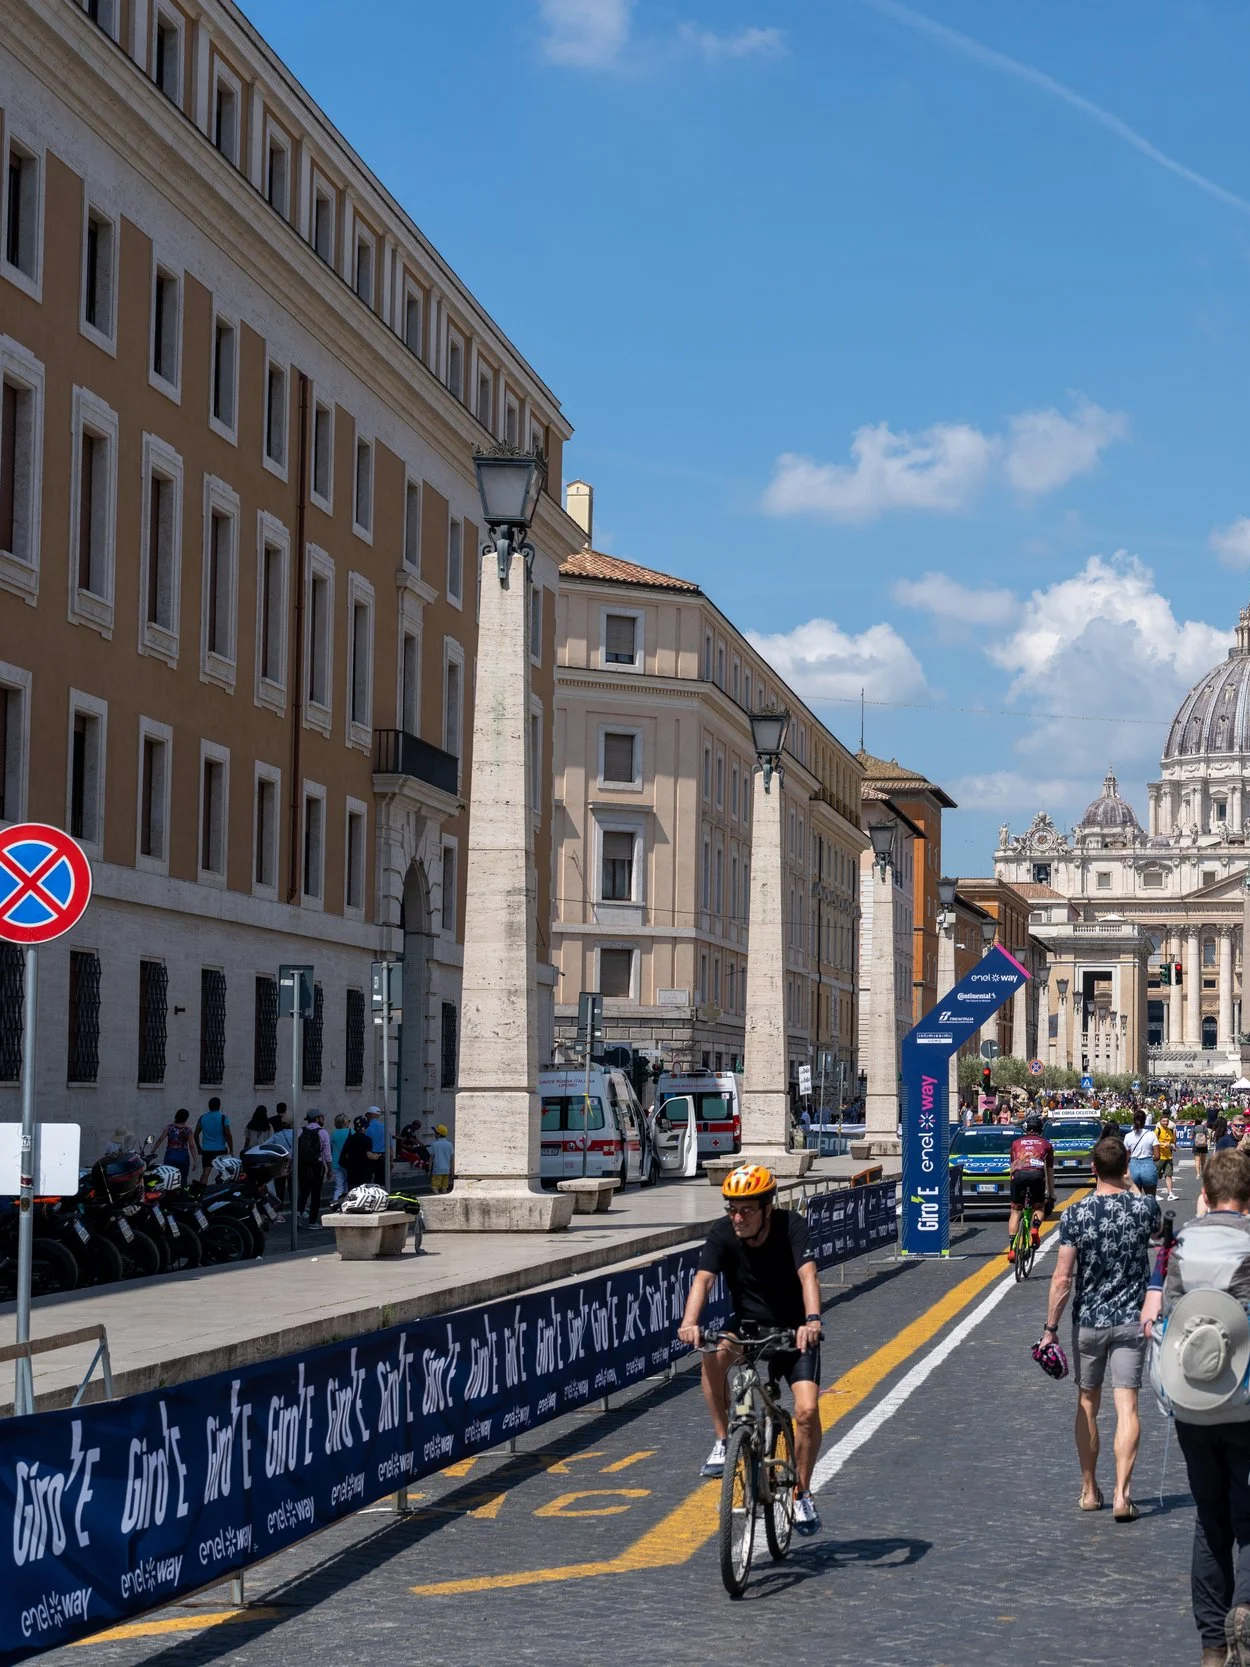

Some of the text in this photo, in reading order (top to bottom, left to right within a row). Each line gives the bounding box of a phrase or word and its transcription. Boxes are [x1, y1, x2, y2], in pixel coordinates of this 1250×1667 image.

[971, 974, 1018, 983] enel way
[957, 992, 991, 1000] Continental
[918, 1075, 938, 1172] enel way
[424, 1434, 454, 1461] enel way
[465, 1419, 492, 1444] enel way
[378, 1451, 414, 1482] enel way
[331, 1472, 365, 1506] enel way
[267, 1495, 314, 1535] enel way
[199, 1524, 253, 1565] enel way
[120, 1554, 183, 1599] enel way
[21, 1587, 92, 1637] enel way
